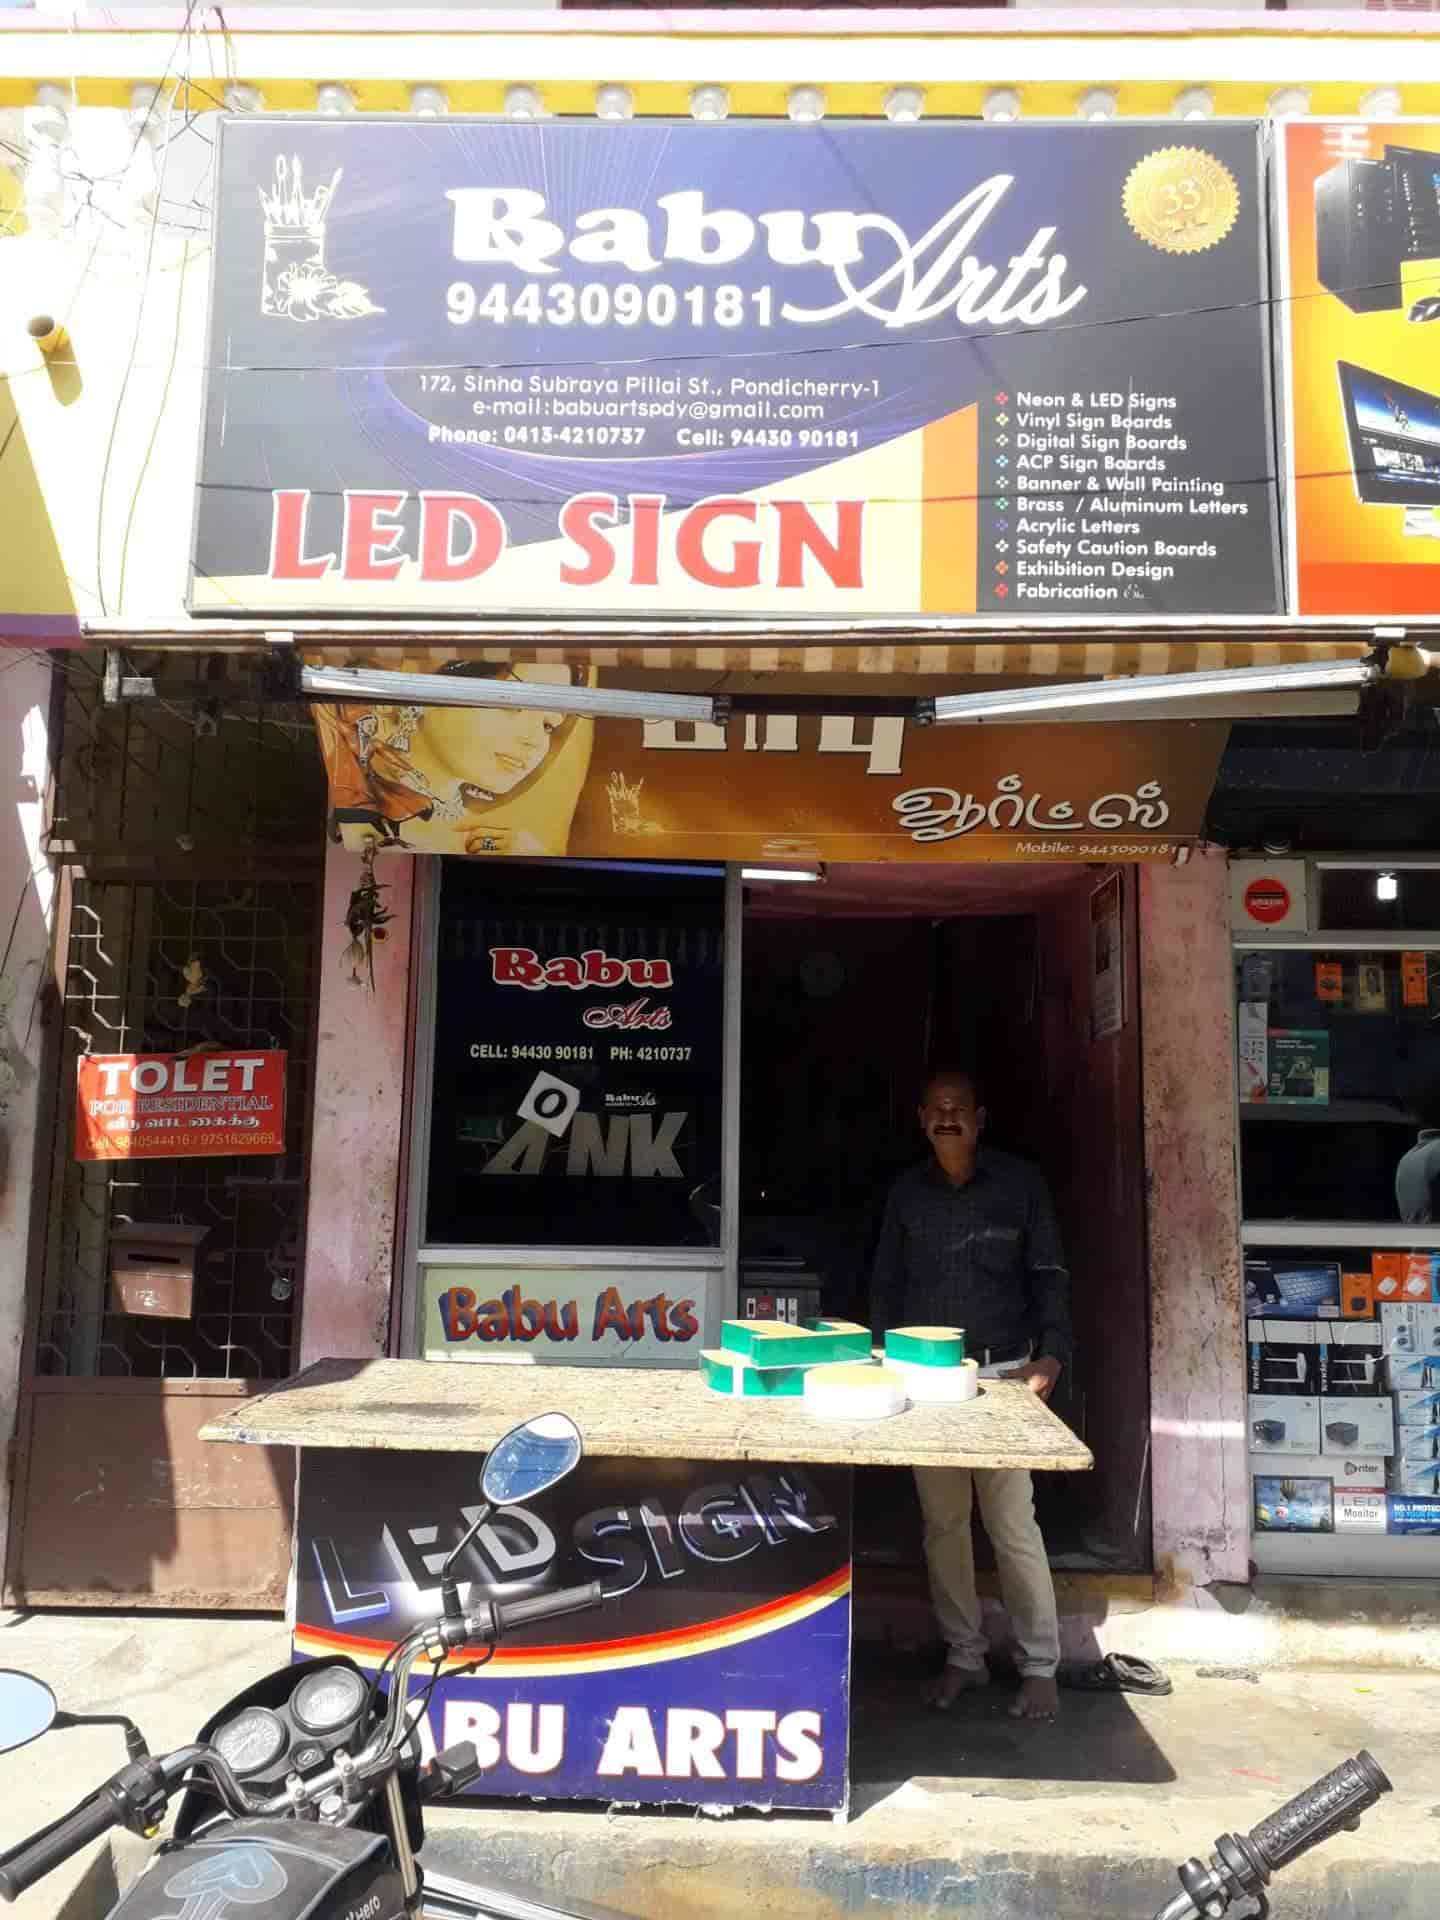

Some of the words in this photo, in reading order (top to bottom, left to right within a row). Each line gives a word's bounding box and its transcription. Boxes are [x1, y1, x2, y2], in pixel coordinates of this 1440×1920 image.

[445, 187, 862, 273] Babu
[781, 174, 1087, 328] Arts
[445, 282, 773, 326] 9443090181
[419, 375, 456, 394] 172,
[529, 375, 618, 395] Subraya
[626, 376, 681, 395] Pillai
[731, 378, 879, 398] Pondicherry-1
[1016, 391, 1065, 407] Neon
[1071, 392, 1083, 407] &
[1090, 393, 1124, 408] LED
[1129, 393, 1177, 411] Signs
[1016, 413, 1060, 430] Vinyl
[1066, 413, 1104, 431] Sign
[1111, 414, 1172, 429] Boards
[428, 425, 497, 443] Phone:
[504, 426, 645, 444] 0413-4210737
[677, 428, 723, 446] Cell:
[731, 429, 792, 446] 94430
[798, 430, 859, 447] 90181
[1016, 433, 1075, 451] Digital
[1081, 434, 1119, 452] Sign
[1126, 435, 1187, 450] Boards
[1016, 455, 1053, 469] ACP
[1059, 455, 1098, 472] Sign
[1104, 456, 1166, 471] Boards
[1016, 475, 1081, 490] Banner
[1087, 476, 1100, 491] &
[1106, 476, 1145, 491] Wall
[1152, 477, 1225, 496] Painting
[1016, 497, 1065, 512] Brass
[1076, 498, 1085, 513] /
[1090, 498, 1183, 513] Aluminum
[1189, 498, 1249, 514] Letters
[1016, 518, 1076, 536] Acrylic
[1081, 519, 1140, 534] Letters
[270, 488, 507, 582] LED
[558, 491, 865, 588] SIGN
[1016, 539, 1071, 558] Safety
[1077, 540, 1148, 556] Caution
[1154, 541, 1217, 556] Boards
[1016, 561, 1105, 577] Exhibition
[1111, 562, 1174, 580] Design
[1016, 583, 1118, 599] Fabrication
[1015, 842, 1074, 854] Mobile:
[489, 947, 673, 990] Babu
[583, 998, 672, 1030] Arts
[470, 1044, 508, 1058] CELL:
[511, 1046, 551, 1060] 94430
[555, 1046, 593, 1060] 90181
[610, 1047, 632, 1060] PH:
[636, 1047, 692, 1061] 4210737
[98, 1059, 265, 1096] TOLET
[137, 1095, 272, 1114] RESIDENTIAL
[439, 1284, 579, 1343] Babu
[592, 1285, 700, 1343] Arts
[1342, 1497, 1382, 1507] LED
[1344, 1508, 1379, 1519] Monitor
[311, 1502, 557, 1624] LED
[597, 1706, 824, 1783] ARTS
